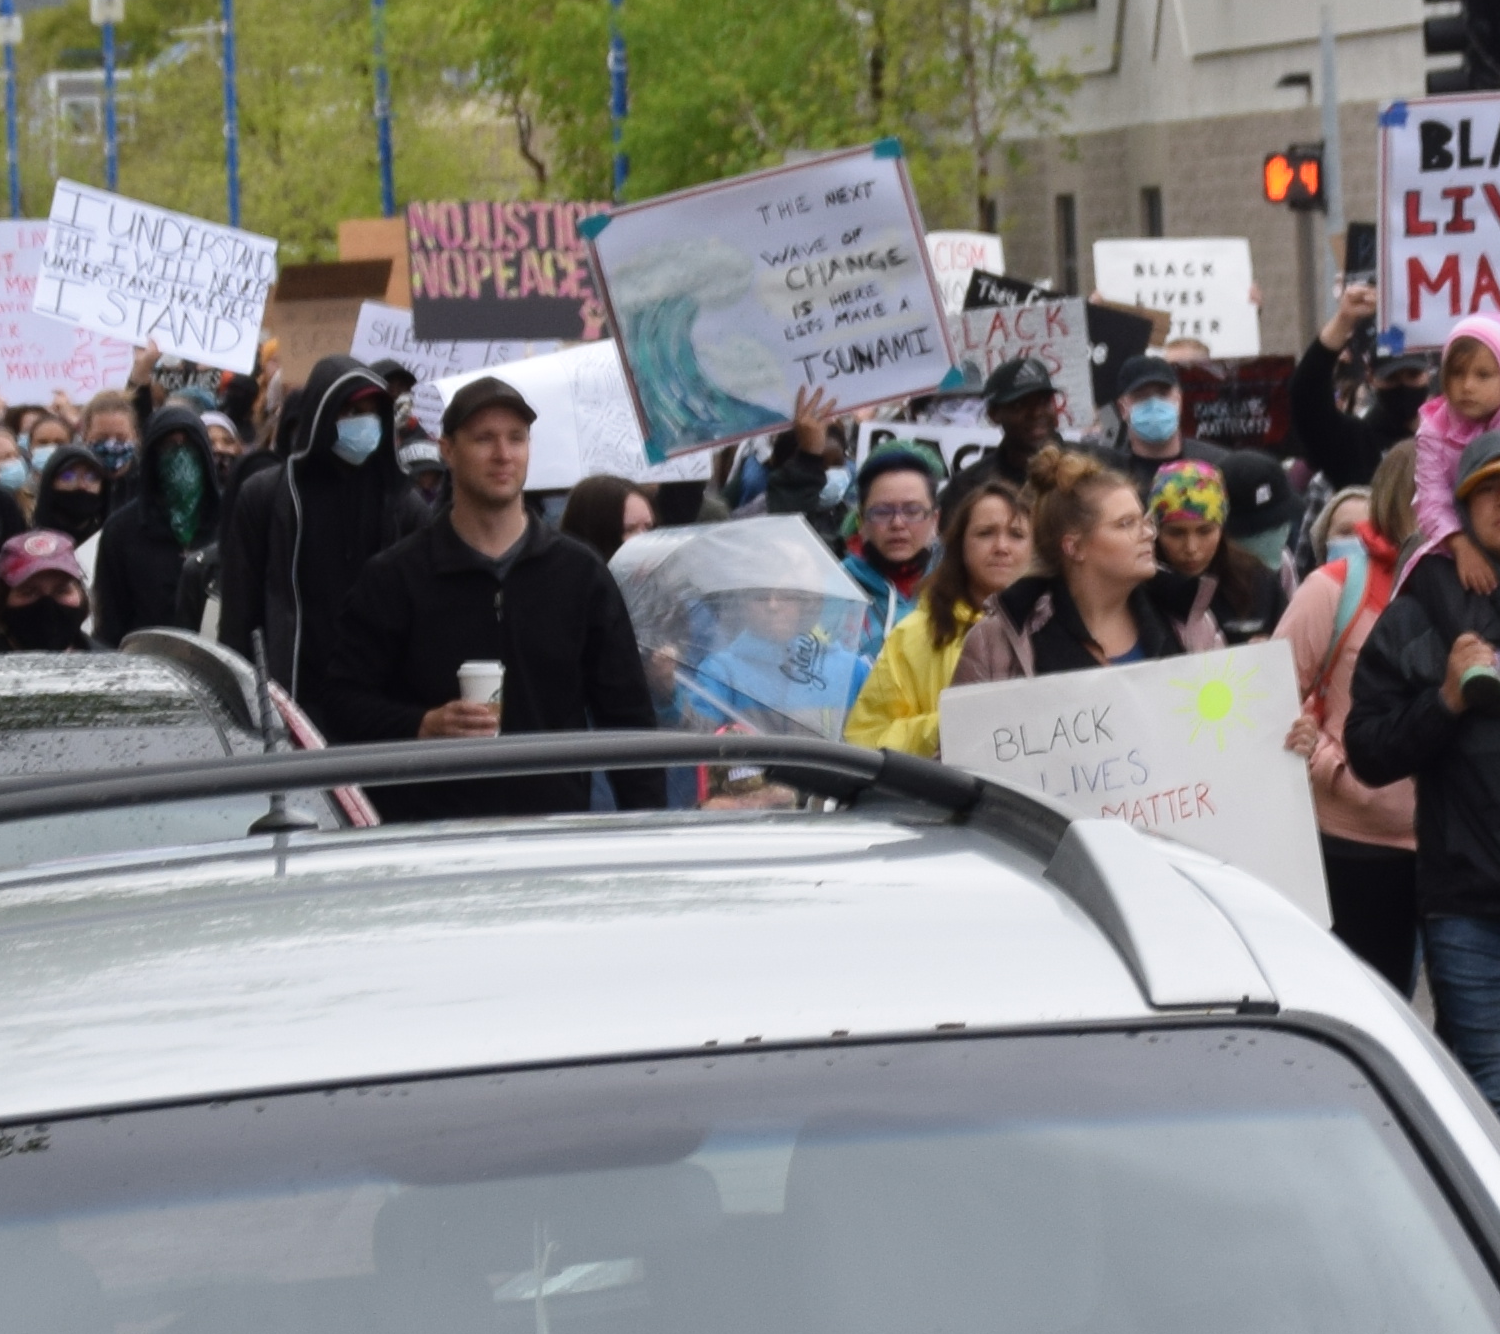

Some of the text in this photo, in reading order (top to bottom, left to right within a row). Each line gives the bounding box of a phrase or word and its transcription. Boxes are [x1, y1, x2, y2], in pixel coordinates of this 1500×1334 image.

[756, 180, 875, 225] THE NEXT
[51, 185, 276, 282] I UNDERSTAND
[463, 200, 612, 257] JUSTIC
[760, 227, 863, 266] WAVE OF
[42, 251, 166, 298] UNDERSTAND
[134, 248, 205, 288] WILL
[209, 268, 268, 304] NEVER
[785, 246, 910, 291] CHANGE
[1134, 263, 1214, 277] BLACK
[36, 274, 85, 322] I
[99, 289, 242, 353] STAND
[784, 297, 910, 342] LETS MAKE A
[792, 281, 879, 319] IS HERE
[1135, 291, 1205, 307] LIVES
[961, 305, 1070, 351] LACK
[793, 325, 933, 386] TSUNAMI
[992, 705, 1114, 762] BLACK
[1040, 749, 1150, 799] LIVES
[1101, 782, 1216, 828] MATTER
